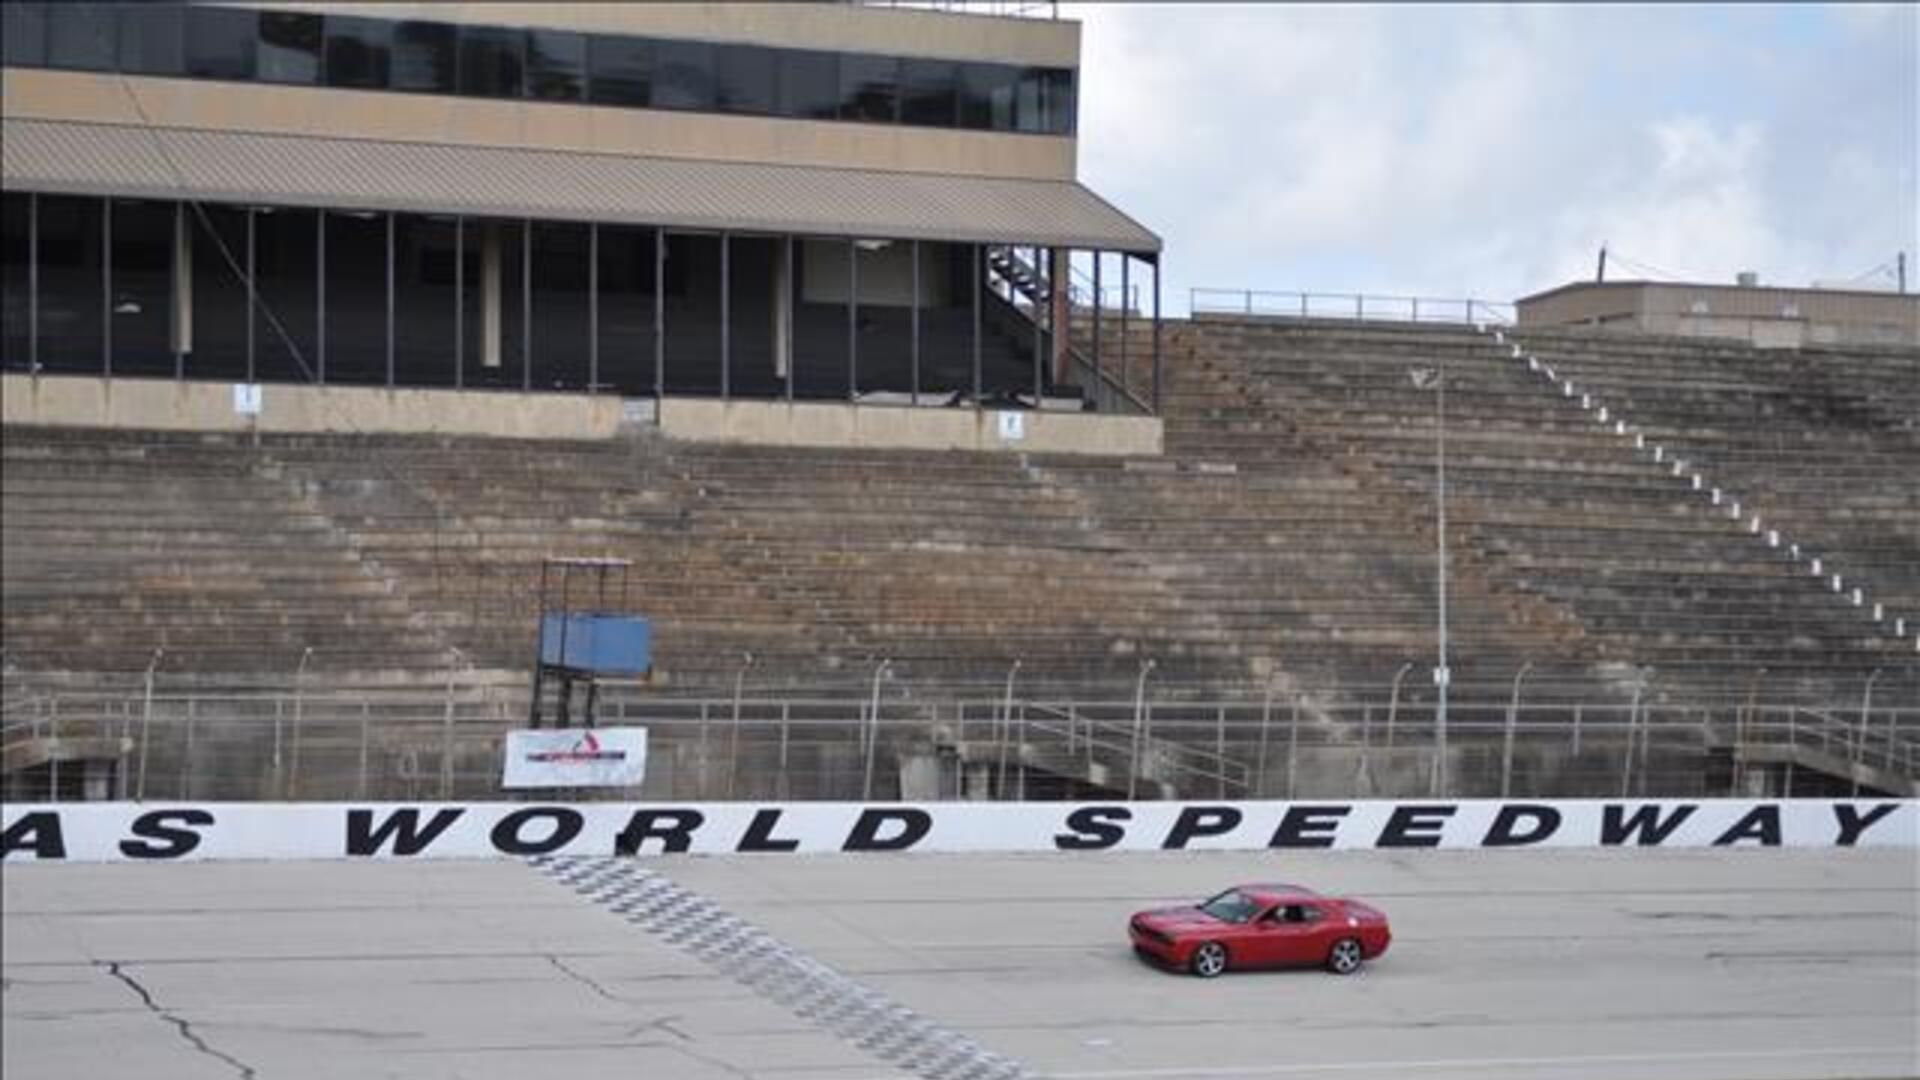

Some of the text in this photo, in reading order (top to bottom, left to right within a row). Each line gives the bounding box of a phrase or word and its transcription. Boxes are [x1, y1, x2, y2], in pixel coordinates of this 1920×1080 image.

[0, 804, 1900, 859] AS WORLD SPEEDWAY
